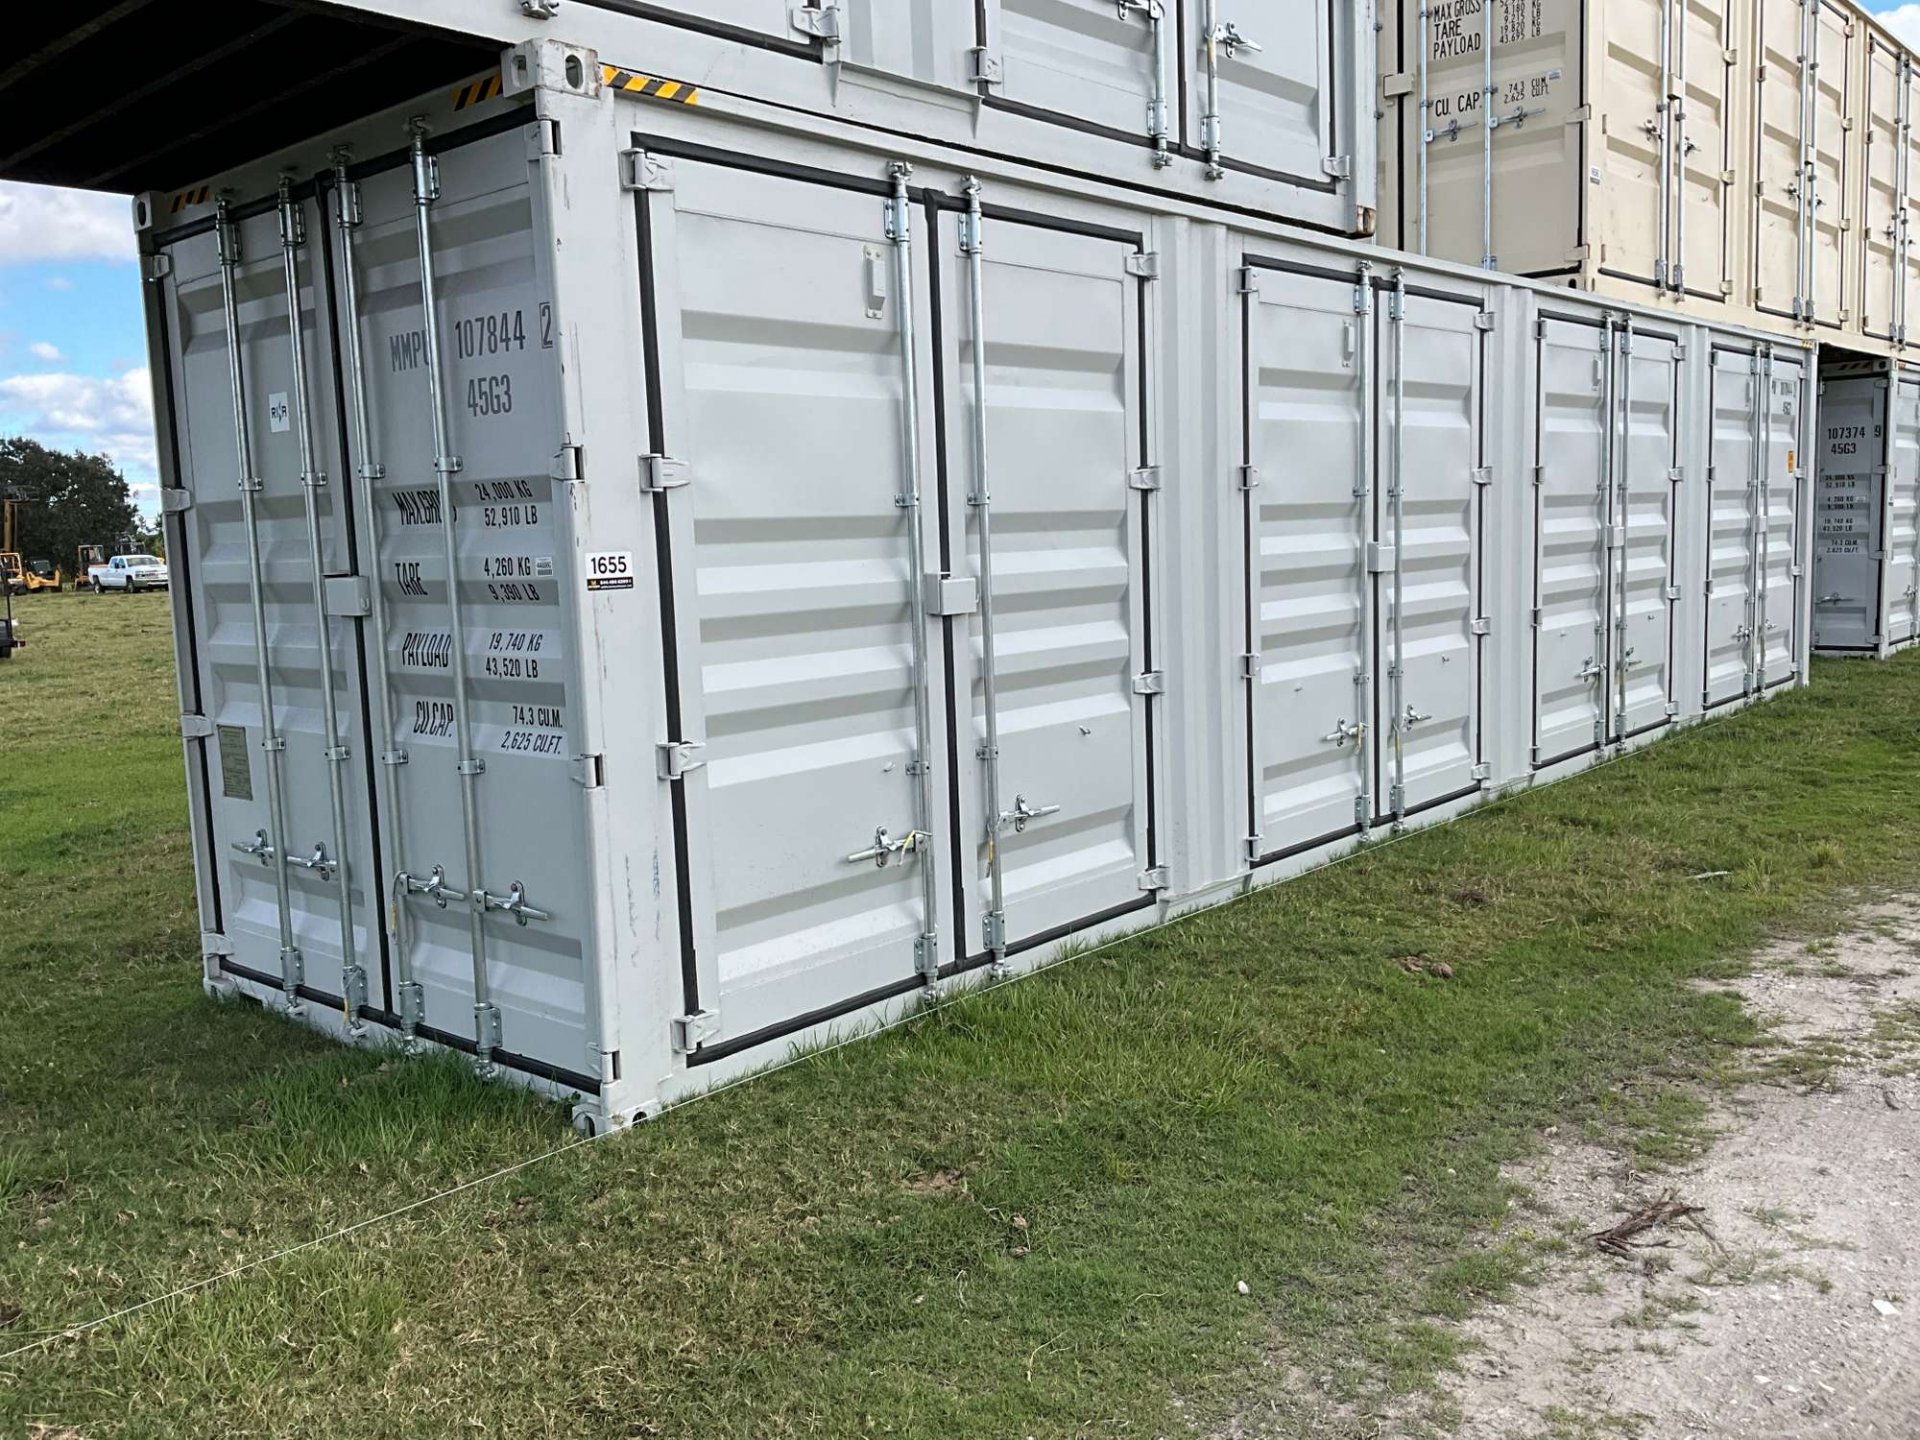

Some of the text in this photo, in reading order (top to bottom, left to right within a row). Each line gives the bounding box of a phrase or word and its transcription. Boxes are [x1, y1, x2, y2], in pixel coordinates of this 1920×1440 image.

[1433, 1, 1453, 22] MAX
[1454, 0, 1481, 18] GROSS
[1434, 18, 1462, 41] TARE
[1433, 32, 1481, 60] PAYLOAD
[1457, 91, 1482, 112] CAP.
[455, 310, 526, 359] 107844
[541, 304, 553, 346] 2
[467, 374, 512, 417] 45G3
[1828, 424, 1882, 440] 107374 9
[1831, 442, 1857, 455] 45G3
[475, 482, 514, 502] 24,000
[515, 480, 533, 498] KG
[484, 505, 538, 529] 52,910 LB
[395, 562, 428, 596] TARE
[484, 557, 514, 579] 4,260
[517, 556, 531, 576] KG
[591, 556, 627, 575] 1655
[488, 583, 540, 603] 9,390 LB
[402, 632, 543, 668] PAYLOAD 19,740 KG
[485, 657, 539, 679] 43,520 LB
[413, 700, 563, 738] CU.CAP. 74.3 CU.M.
[501, 730, 533, 752] 2,625
